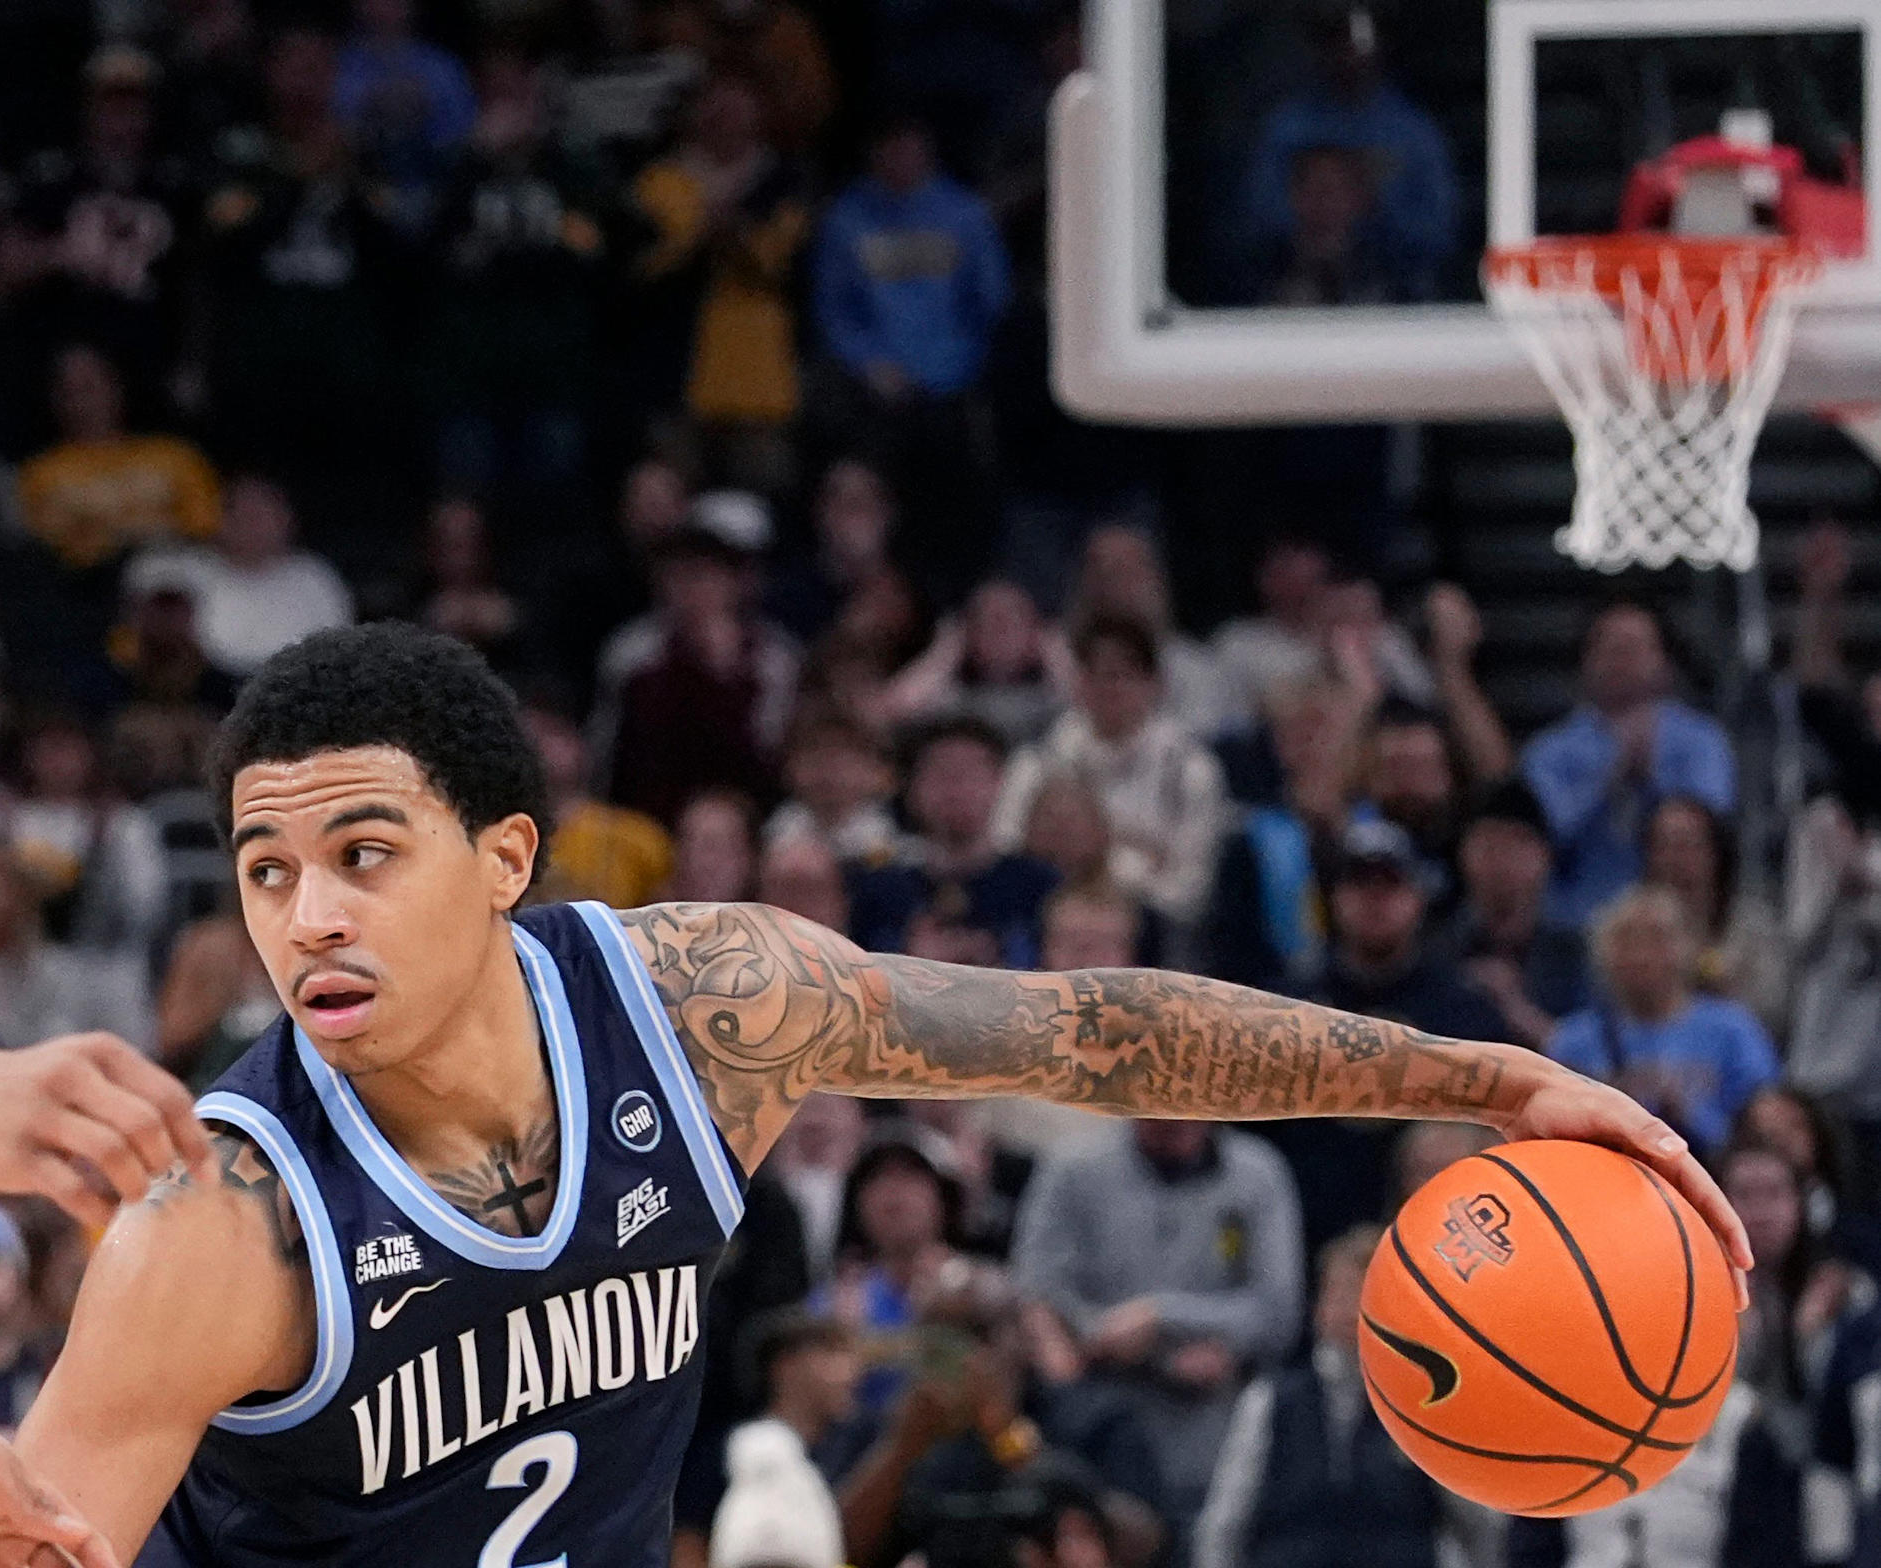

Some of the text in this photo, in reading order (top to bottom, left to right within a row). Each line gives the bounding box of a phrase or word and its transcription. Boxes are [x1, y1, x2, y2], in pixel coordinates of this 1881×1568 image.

[619, 1104, 654, 1138] GHR
[617, 1177, 653, 1219] BIG
[617, 1186, 668, 1237] EAST
[355, 1251, 422, 1286] CHANGE
[356, 1234, 416, 1265] BE THE
[350, 1264, 699, 1495] VILLANOVA
